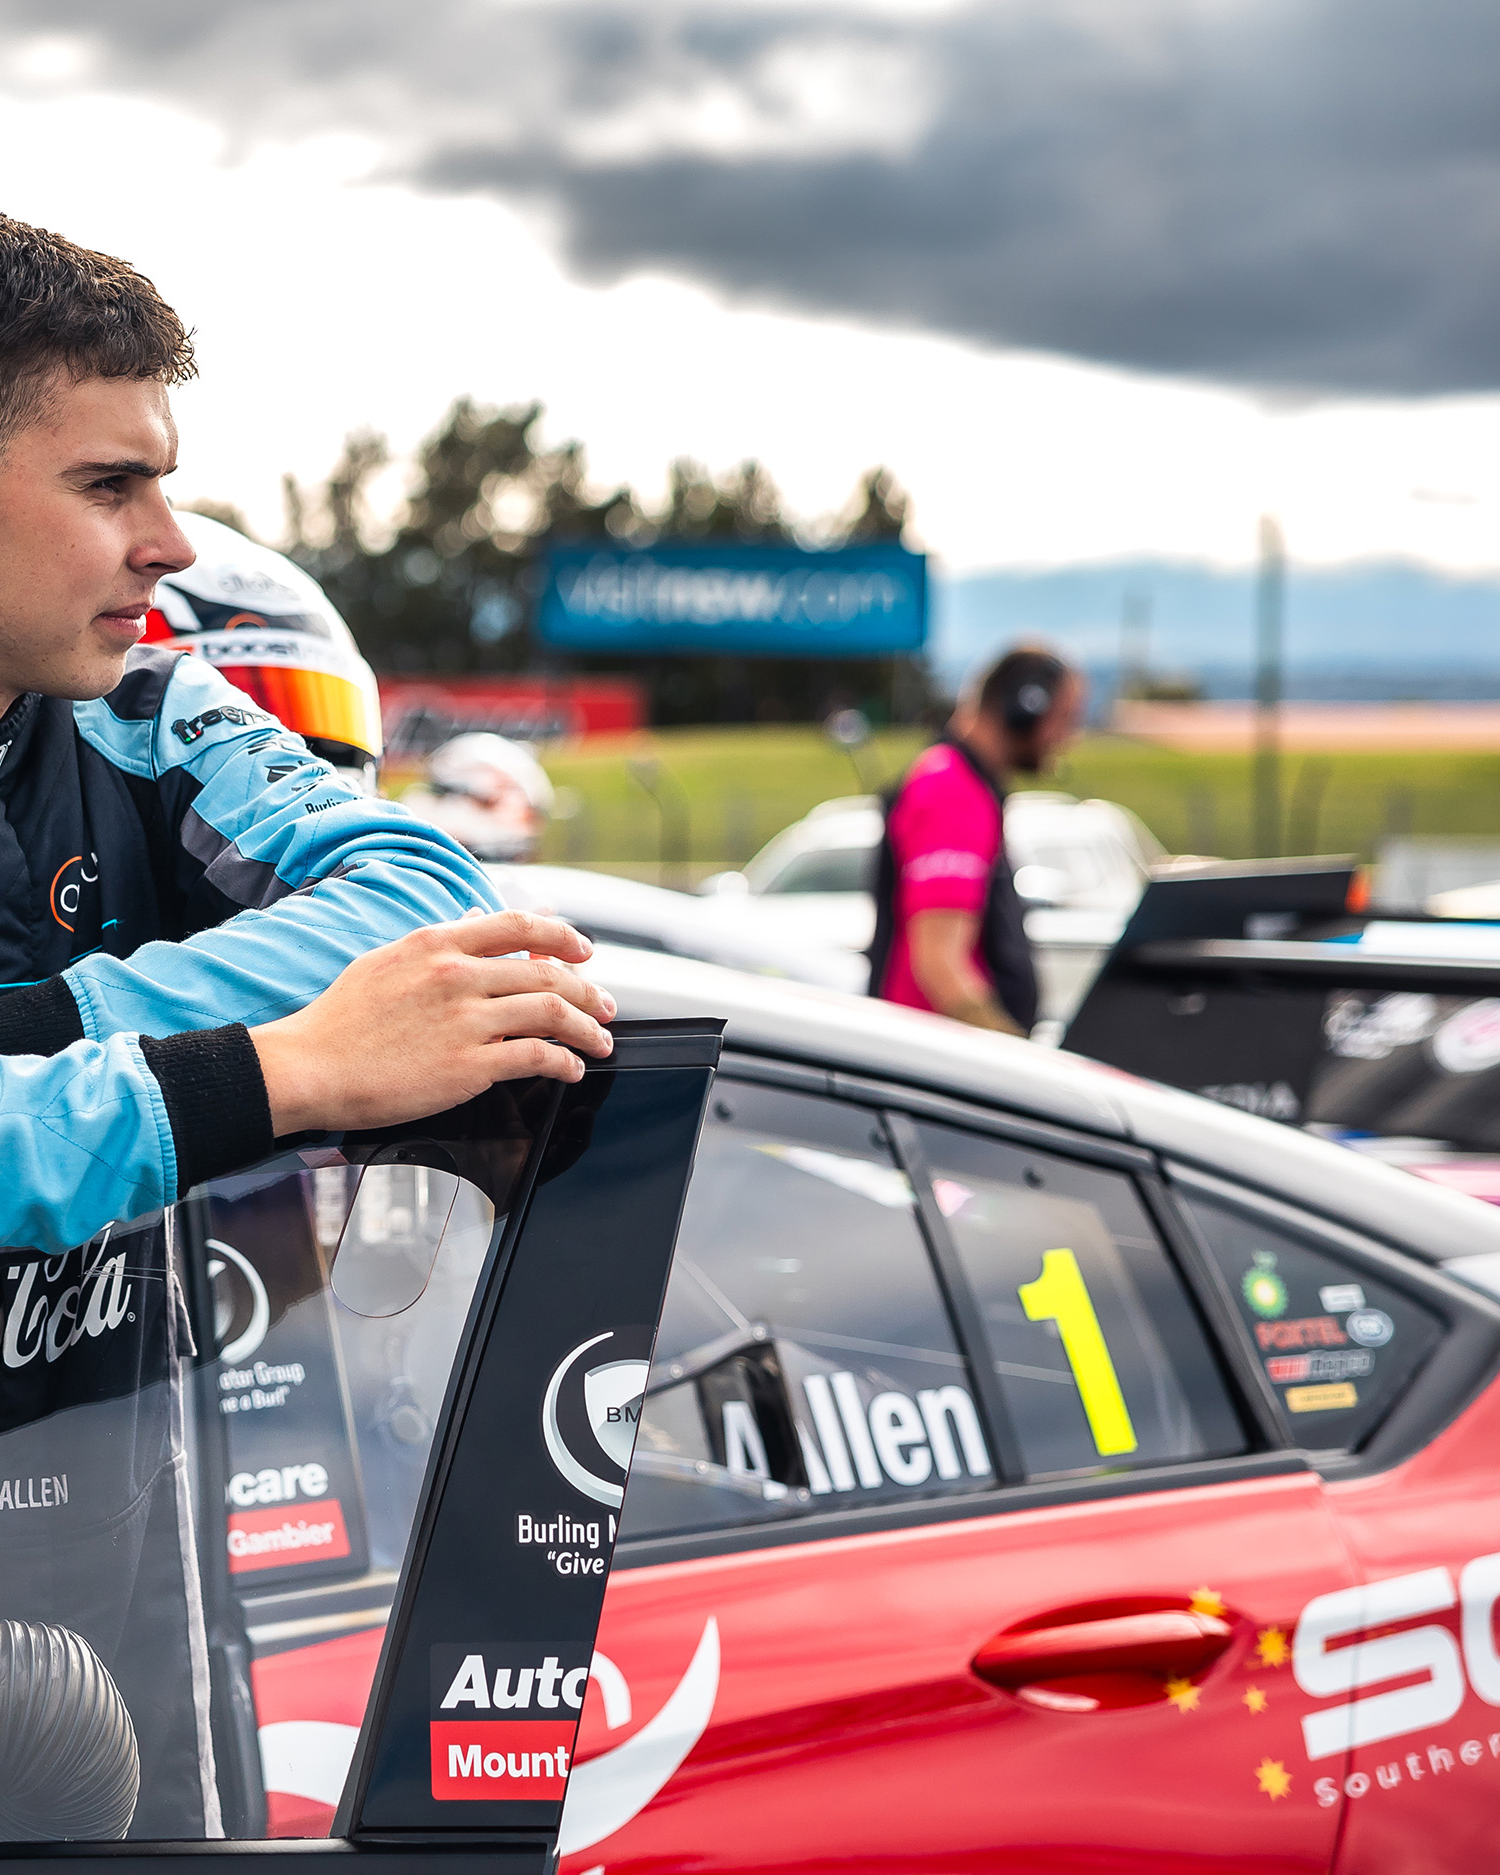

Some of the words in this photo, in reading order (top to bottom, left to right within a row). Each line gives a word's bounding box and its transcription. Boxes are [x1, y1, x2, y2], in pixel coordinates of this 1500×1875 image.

[1018, 1246, 1138, 1457] 1
[228, 1463, 329, 1507] care
[227, 1520, 335, 1558] Gambier
[517, 1514, 600, 1549] Burling
[447, 1744, 570, 1778] Mount
